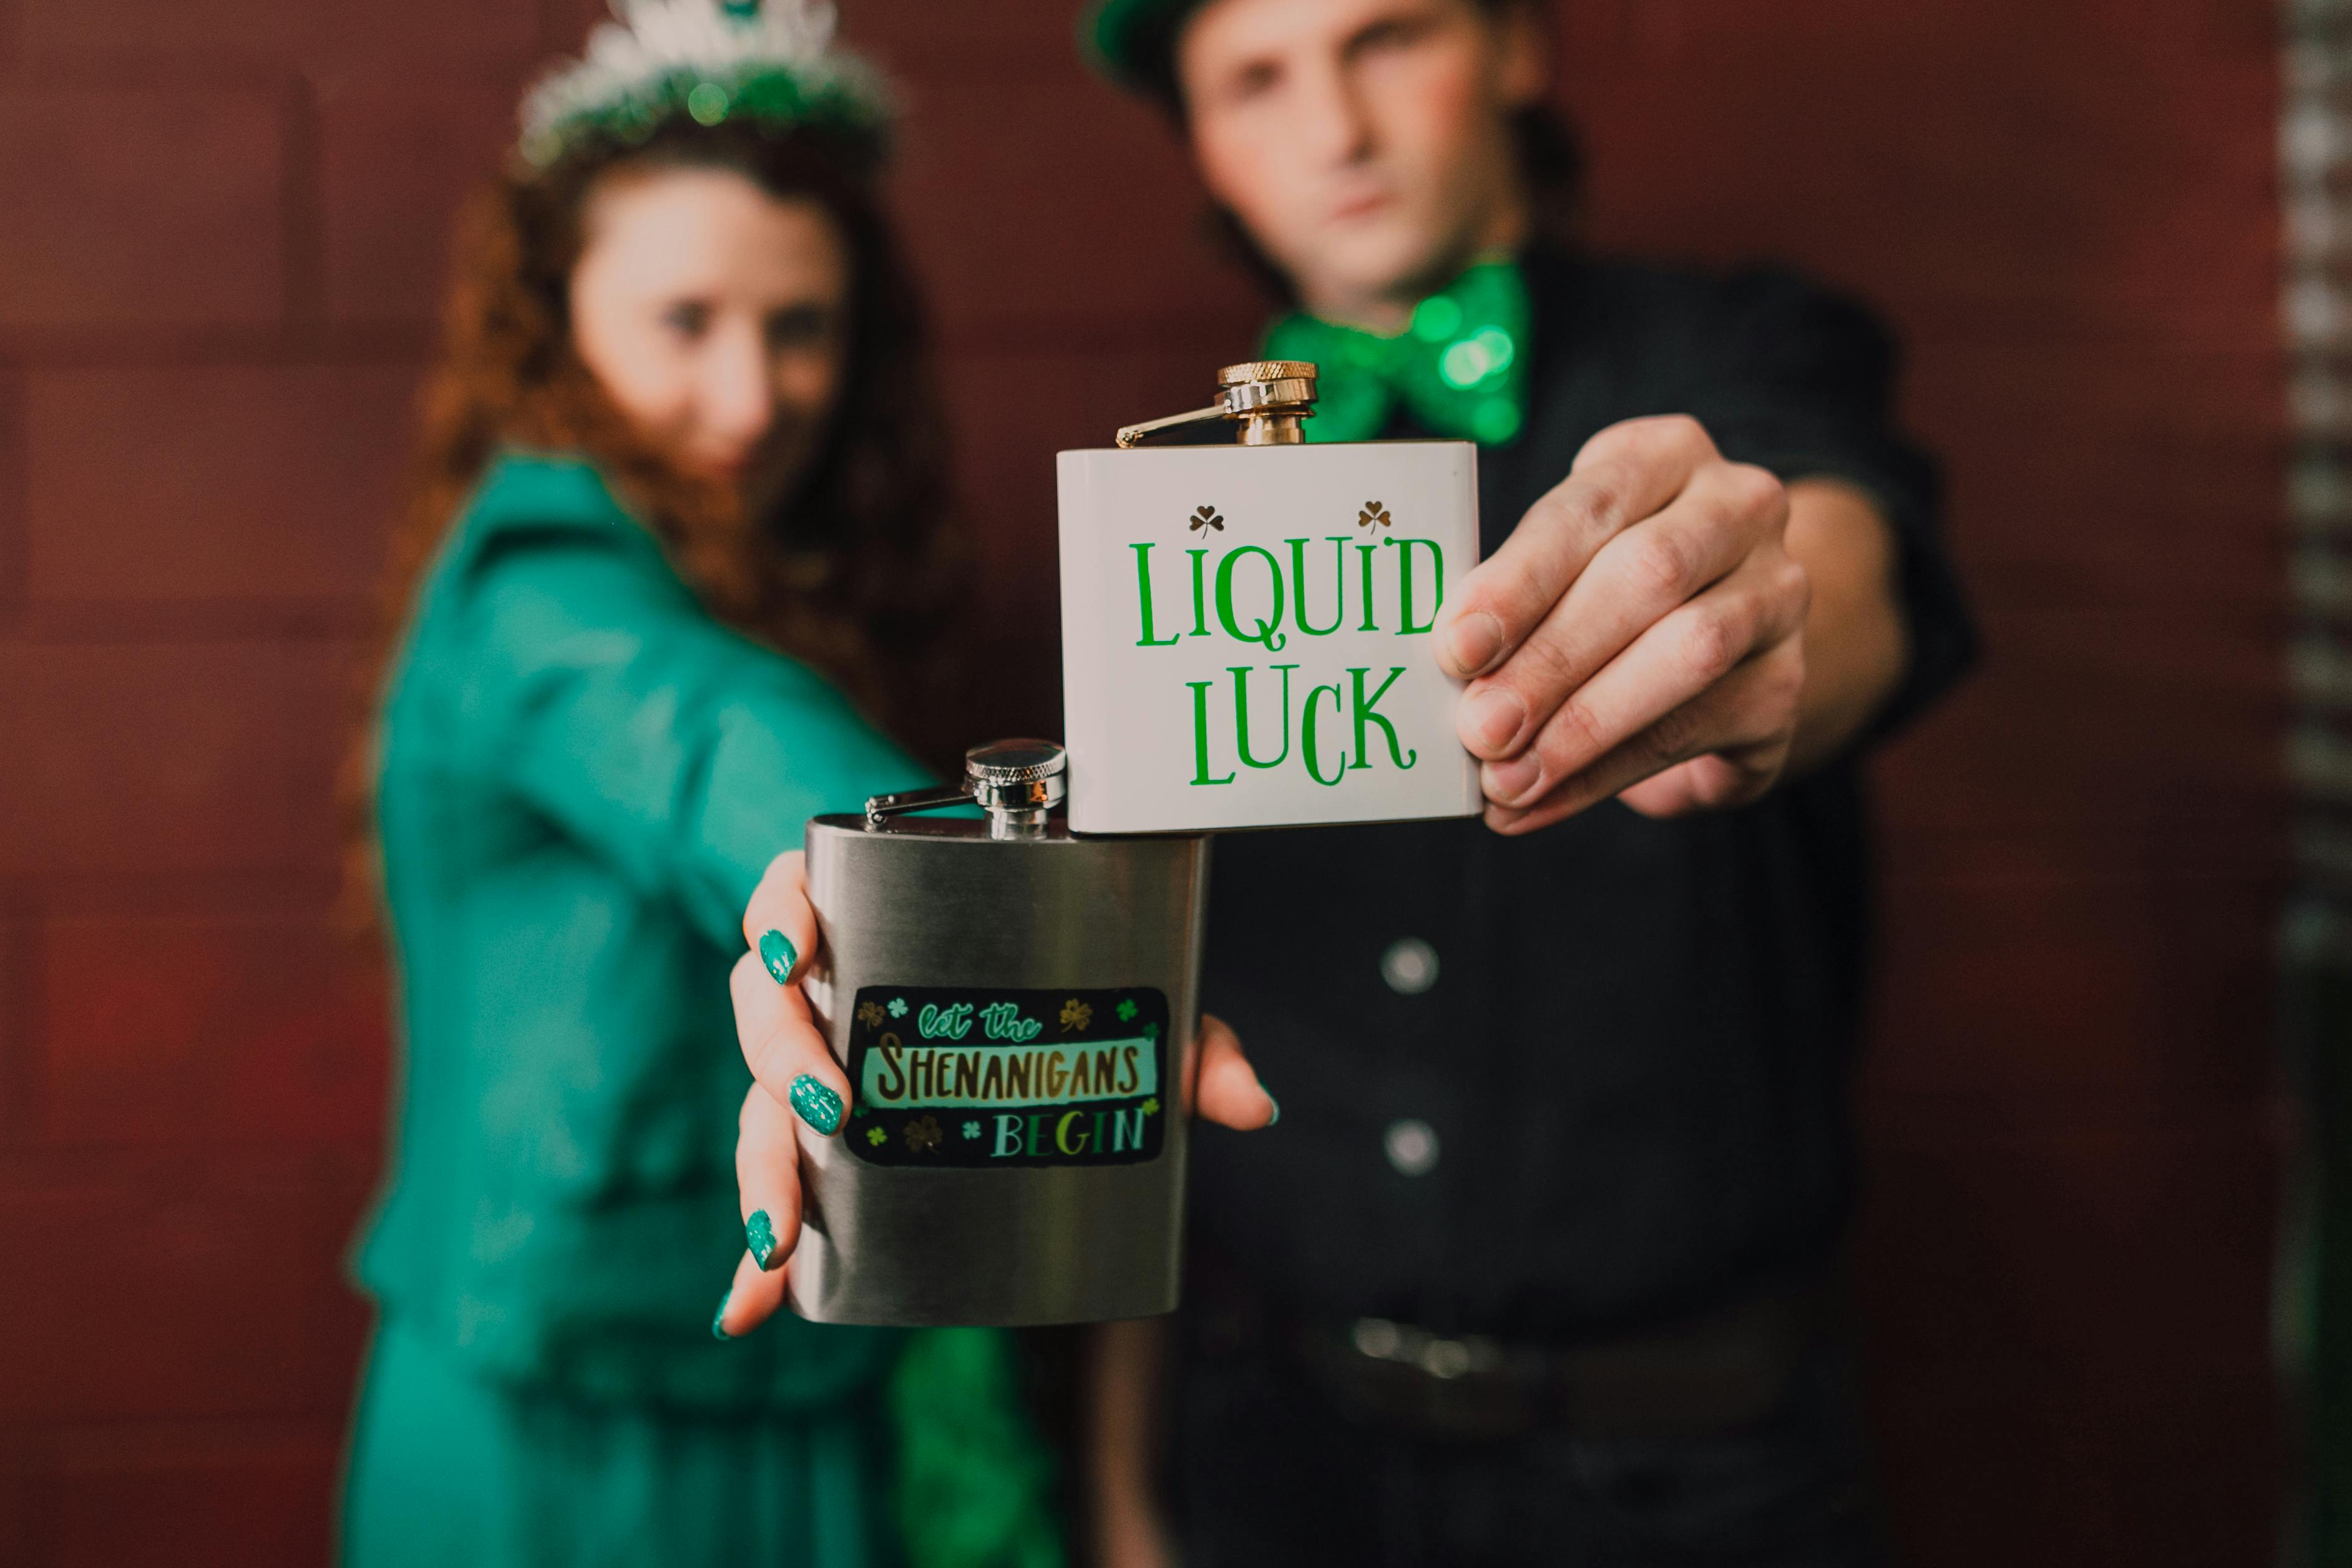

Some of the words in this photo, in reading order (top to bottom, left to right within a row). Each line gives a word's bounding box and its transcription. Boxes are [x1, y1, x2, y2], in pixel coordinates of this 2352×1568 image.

[1129, 536, 1444, 653] LIQUID
[1185, 664, 1418, 787] LUCK
[919, 1003, 973, 1040] let
[979, 1002, 1043, 1042] the
[878, 1032, 1139, 1101] SHENANIGANS
[990, 1108, 1145, 1157] BEGIN
